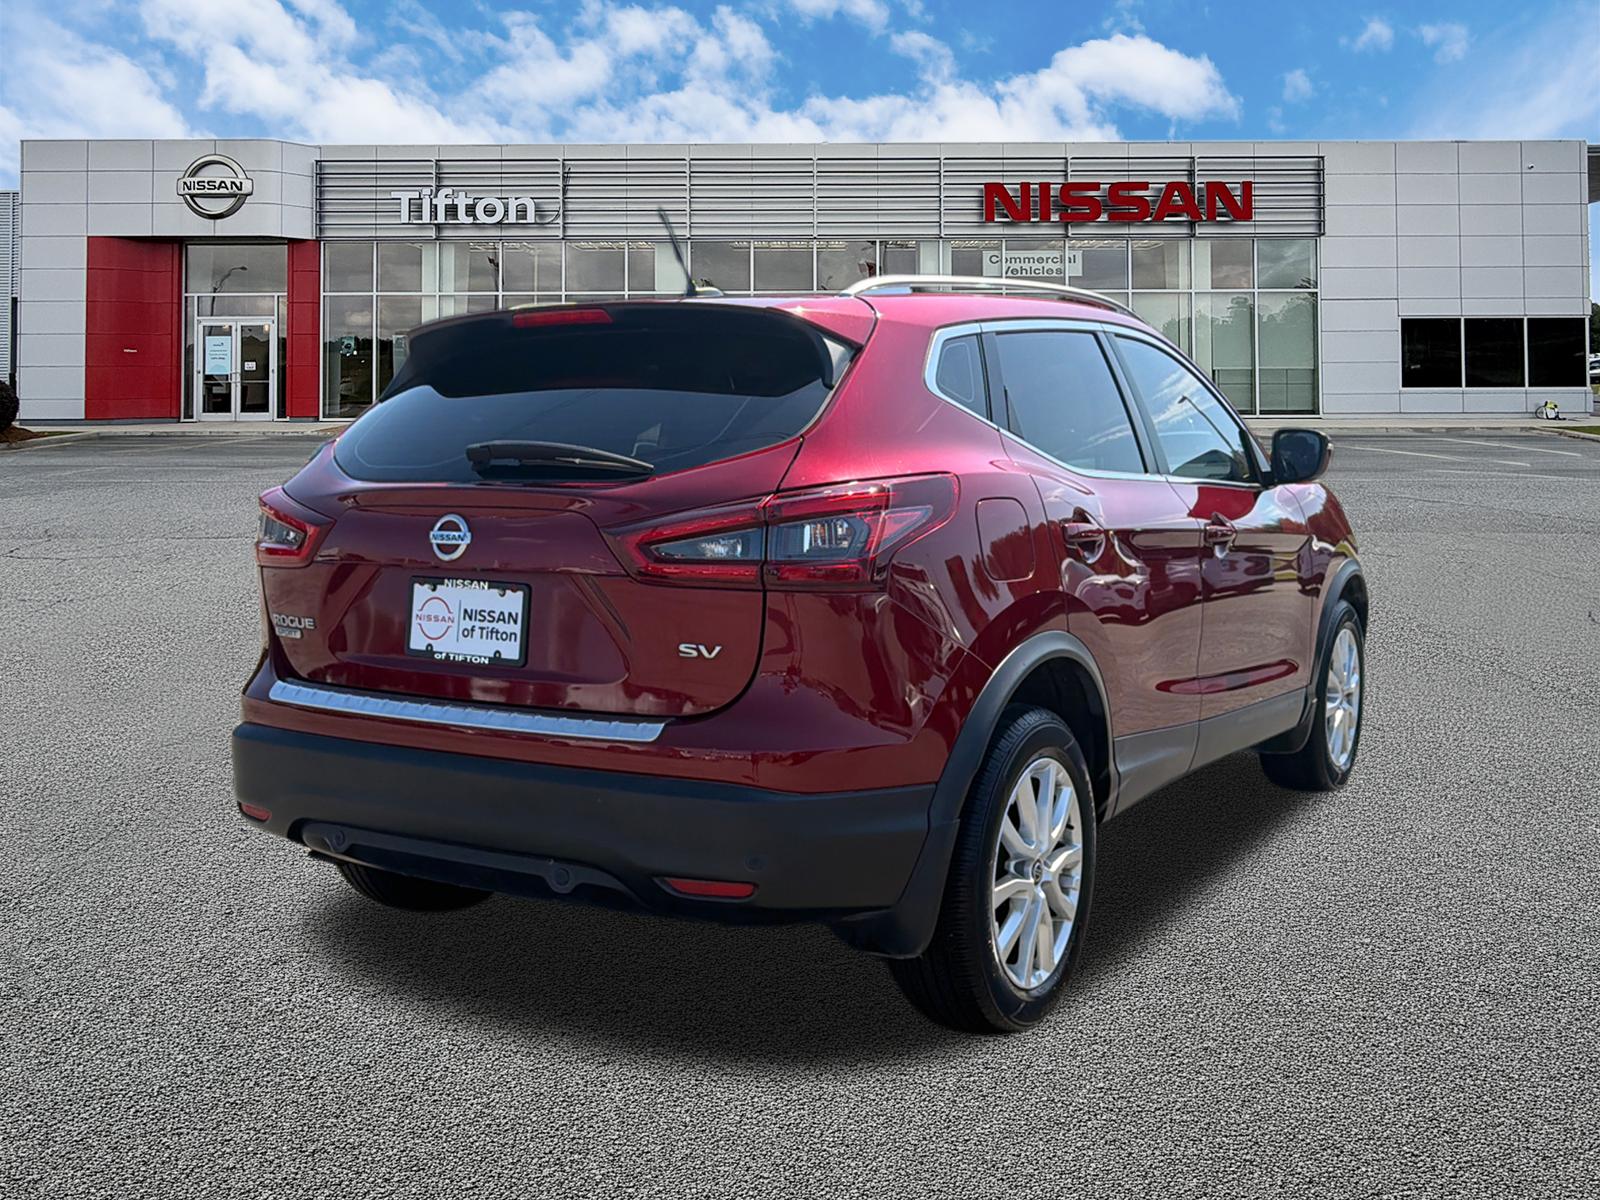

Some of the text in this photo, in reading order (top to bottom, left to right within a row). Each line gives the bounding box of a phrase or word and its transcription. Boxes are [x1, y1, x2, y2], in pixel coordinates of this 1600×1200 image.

[183, 180, 243, 192] NISSAN
[391, 188, 536, 224] Tifton
[984, 181, 1253, 222] NISSAN
[431, 532, 466, 542] NISSAN
[444, 579, 489, 591] NISSAN
[272, 613, 316, 630] ROGUE
[415, 613, 455, 624] NISSAN
[462, 607, 519, 626] NISSAN
[461, 625, 518, 643] of Tifton
[434, 652, 490, 665] of TIFTON
[678, 643, 722, 659] SV
